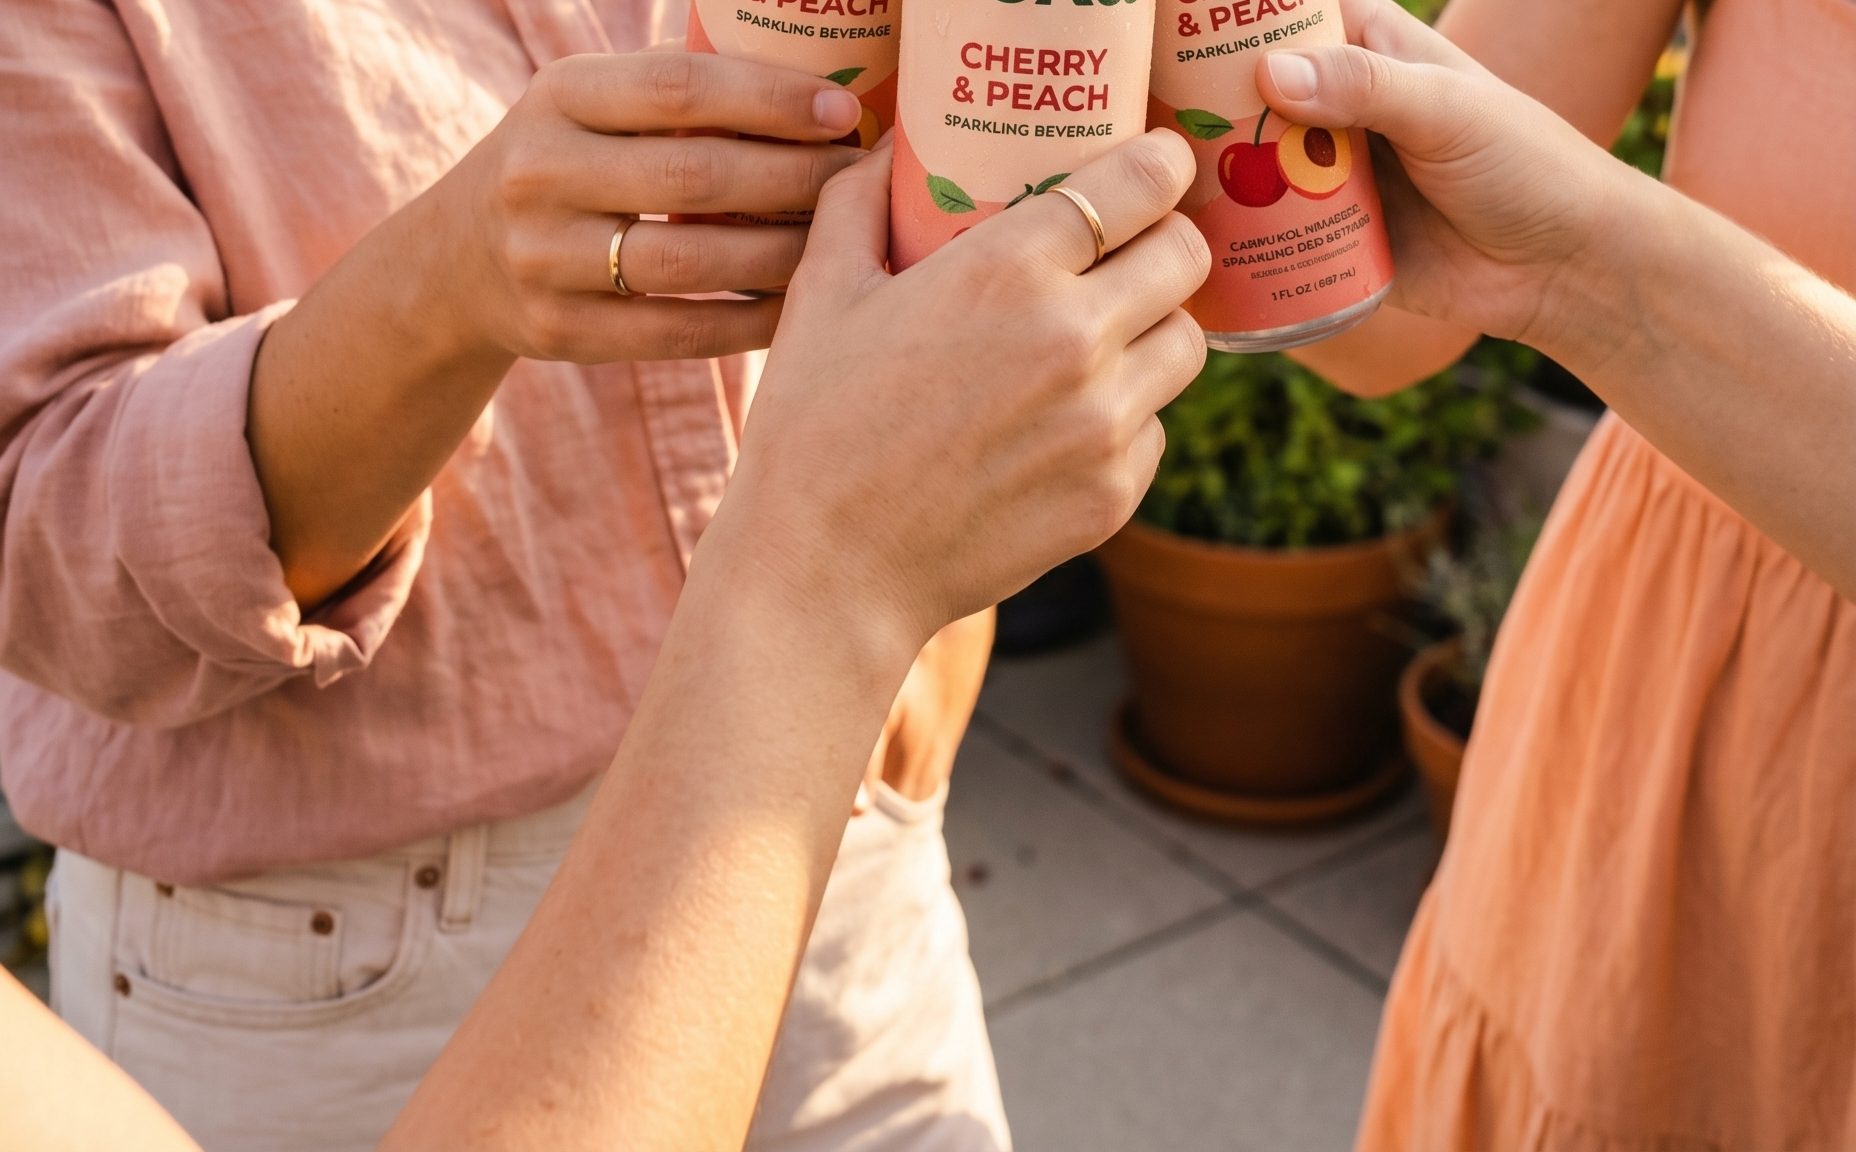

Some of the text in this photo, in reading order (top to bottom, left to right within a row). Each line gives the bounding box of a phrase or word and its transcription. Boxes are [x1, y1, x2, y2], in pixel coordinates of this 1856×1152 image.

[736, 9, 892, 39] SPARKLING BEVERAGE
[1177, 12, 1202, 37] &
[960, 42, 1109, 76] CHERRY
[1176, 35, 1260, 63] SPARKLING
[952, 75, 1109, 112] & PEACH
[944, 113, 1113, 138] SPARKLING BEVERAGE
[1279, 289, 1294, 300] FL
[1295, 283, 1312, 295] OZ
